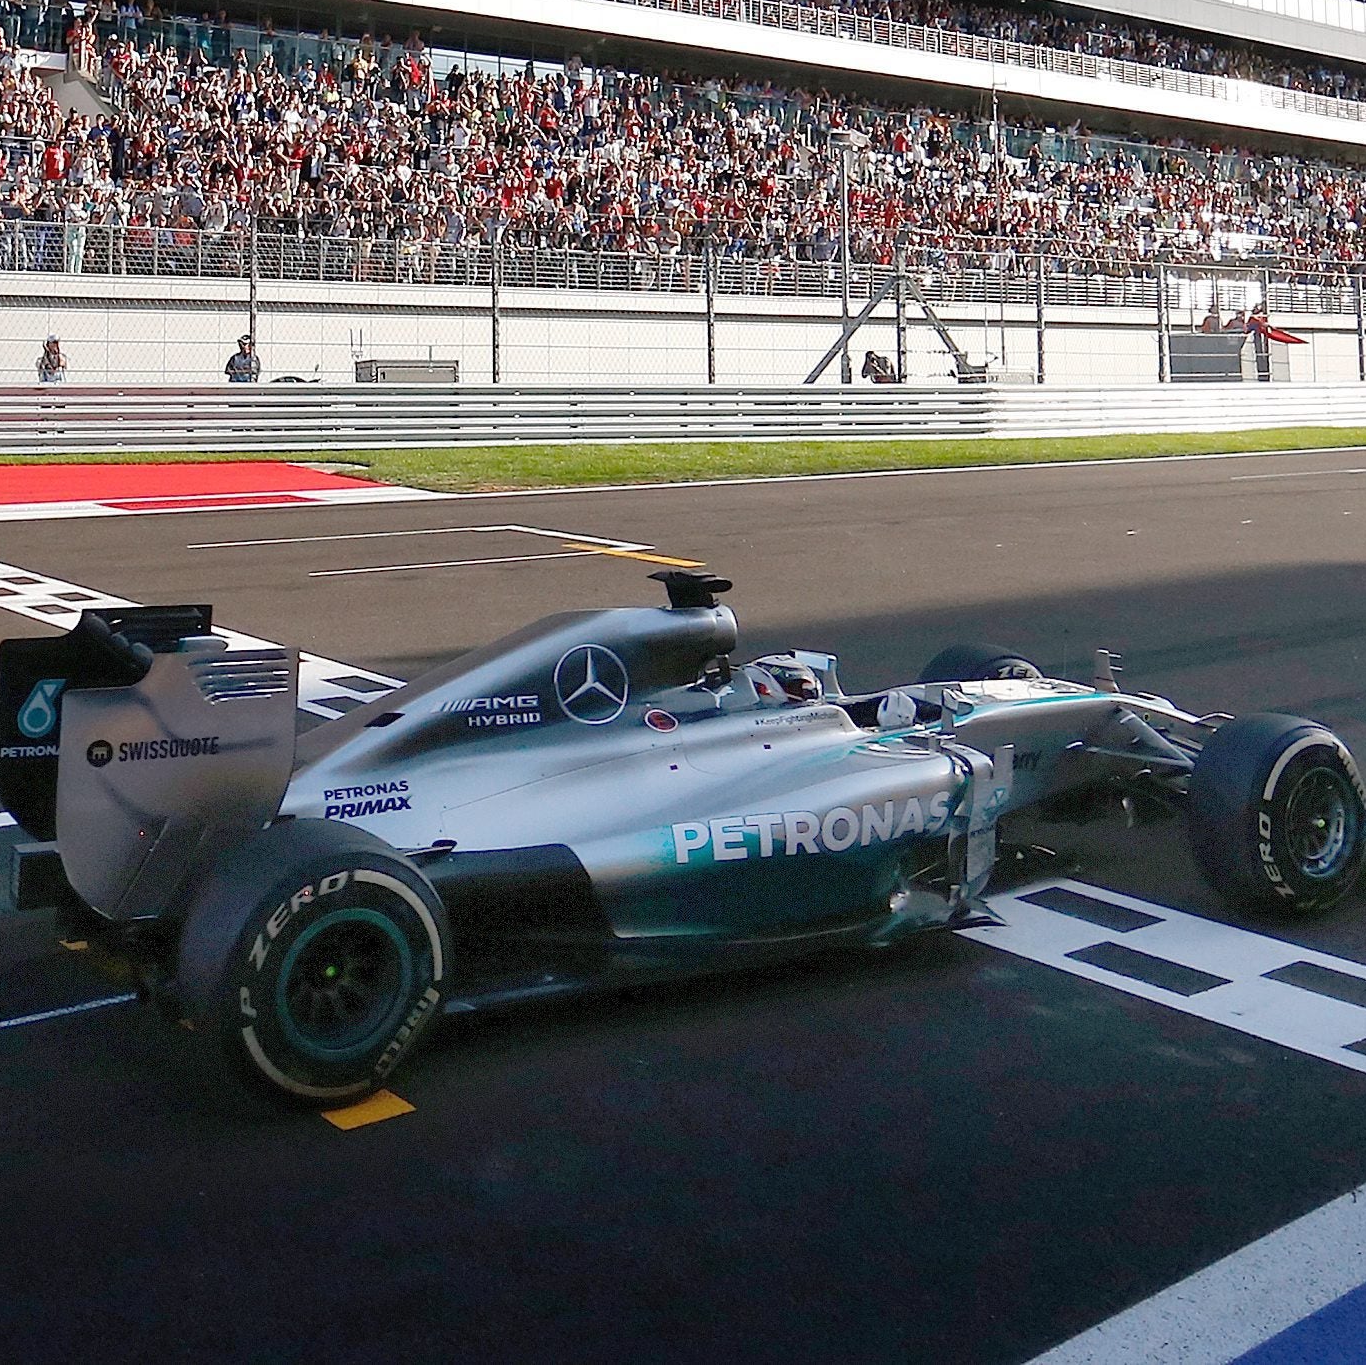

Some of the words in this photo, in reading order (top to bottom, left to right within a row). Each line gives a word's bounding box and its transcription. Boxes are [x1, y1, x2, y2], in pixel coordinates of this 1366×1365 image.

[468, 694, 539, 711] AMG
[467, 712, 541, 727] HYBRID
[118, 735, 221, 762] SWISSQUOTE
[323, 780, 409, 802] PETRONAS
[324, 795, 413, 820] PRIMAX
[671, 790, 953, 865] PETRONAS
[1258, 811, 1295, 897] ZERO
[248, 870, 350, 972] ZERO
